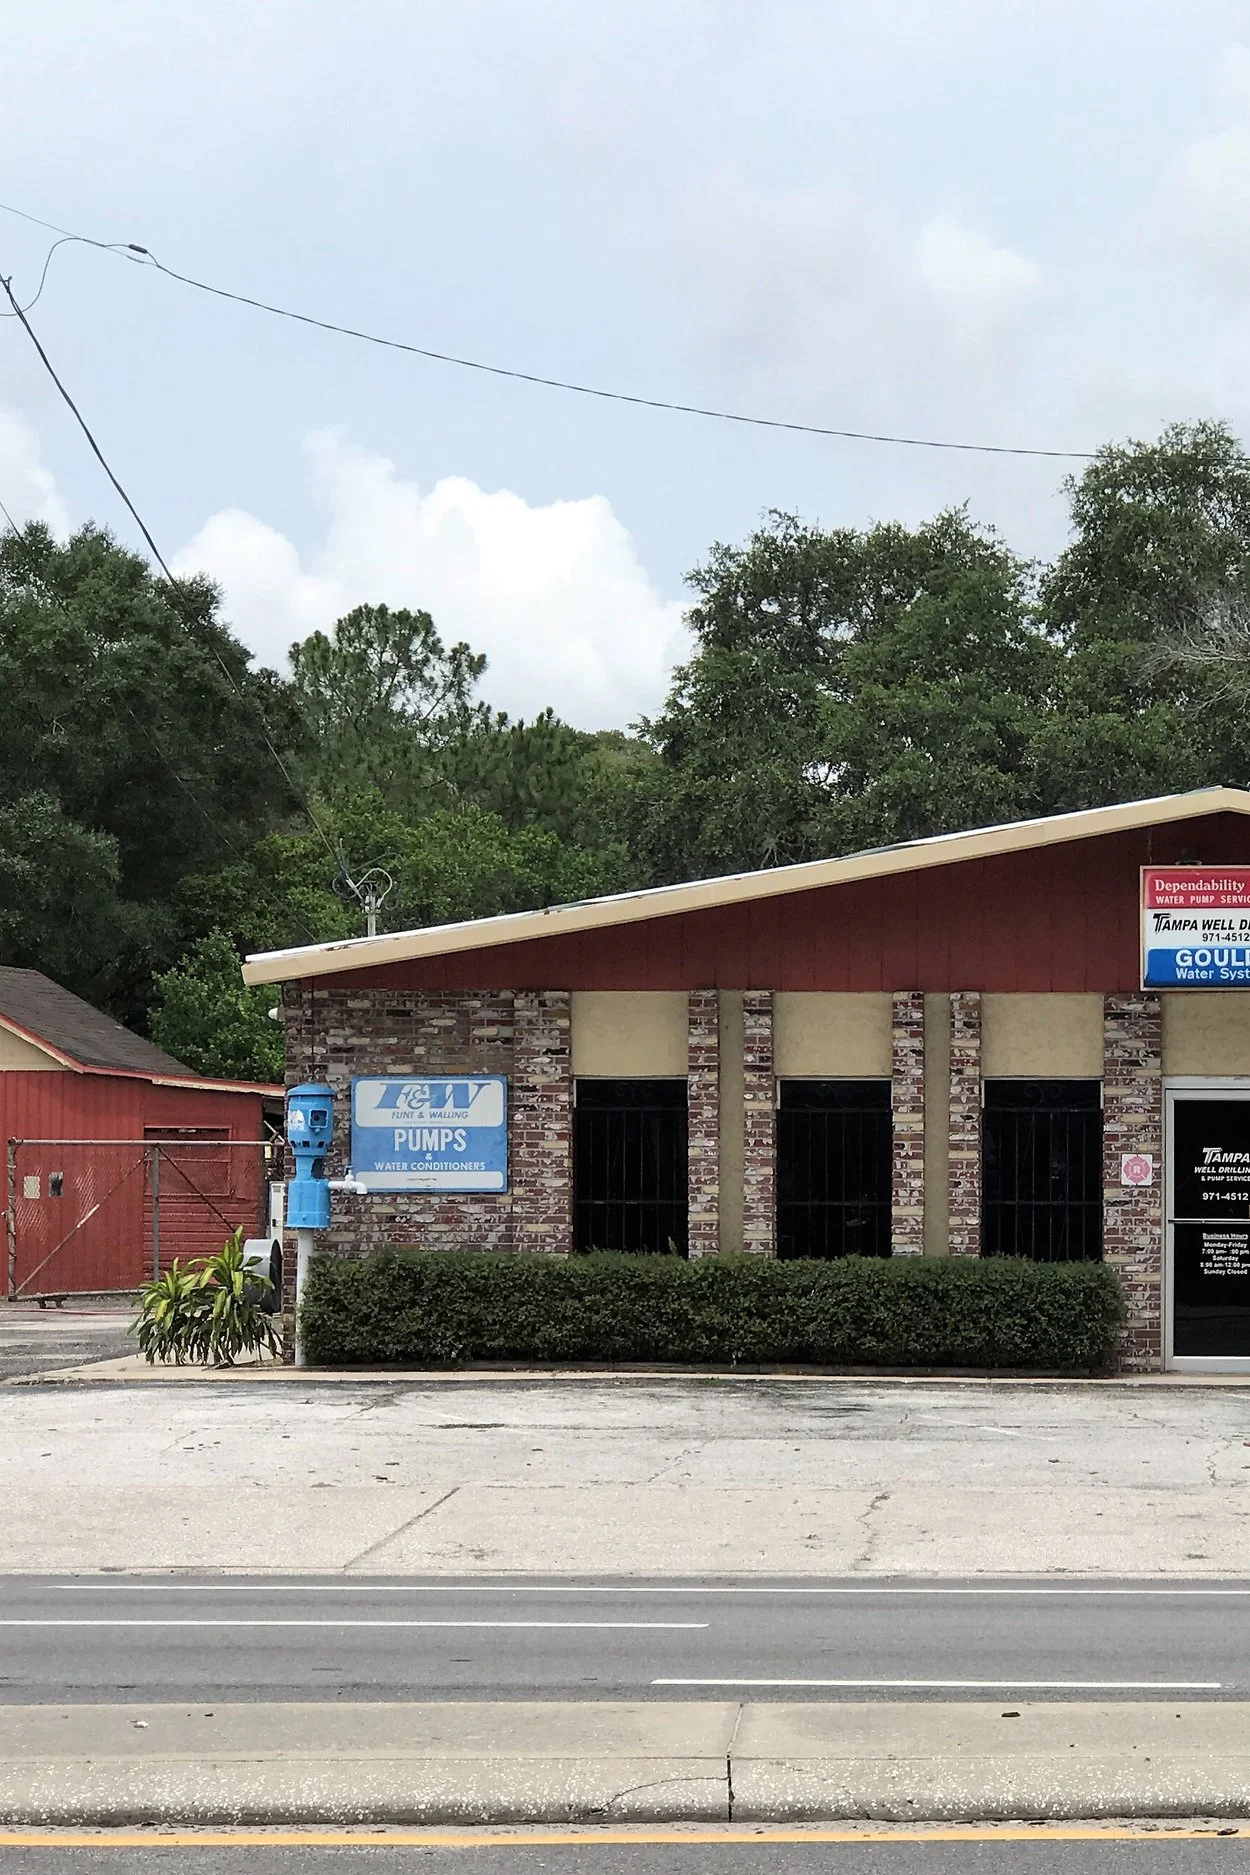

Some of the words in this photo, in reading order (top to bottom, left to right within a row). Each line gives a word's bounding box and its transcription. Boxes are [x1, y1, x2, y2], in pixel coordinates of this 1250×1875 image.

[1155, 879, 1245, 893] Dependability
[1155, 895, 1185, 904] WATER
[1190, 895, 1215, 904] PUMP
[1153, 913, 1198, 934] TAMPA
[1202, 919, 1235, 930] WELL
[1202, 933, 1250, 942] 971-4512
[1176, 968, 1214, 979] Water
[391, 1111, 415, 1119] FLINT
[418, 1111, 425, 1119] &
[429, 1111, 469, 1119] WALLING
[394, 1129, 467, 1151] PUMPS
[1202, 1147, 1250, 1165] TAMPA
[374, 1162, 408, 1171] WATER
[410, 1162, 486, 1171] CONDITIONERS
[1194, 1166, 1217, 1174] WELL
[1202, 1192, 1249, 1201] 971-4512
